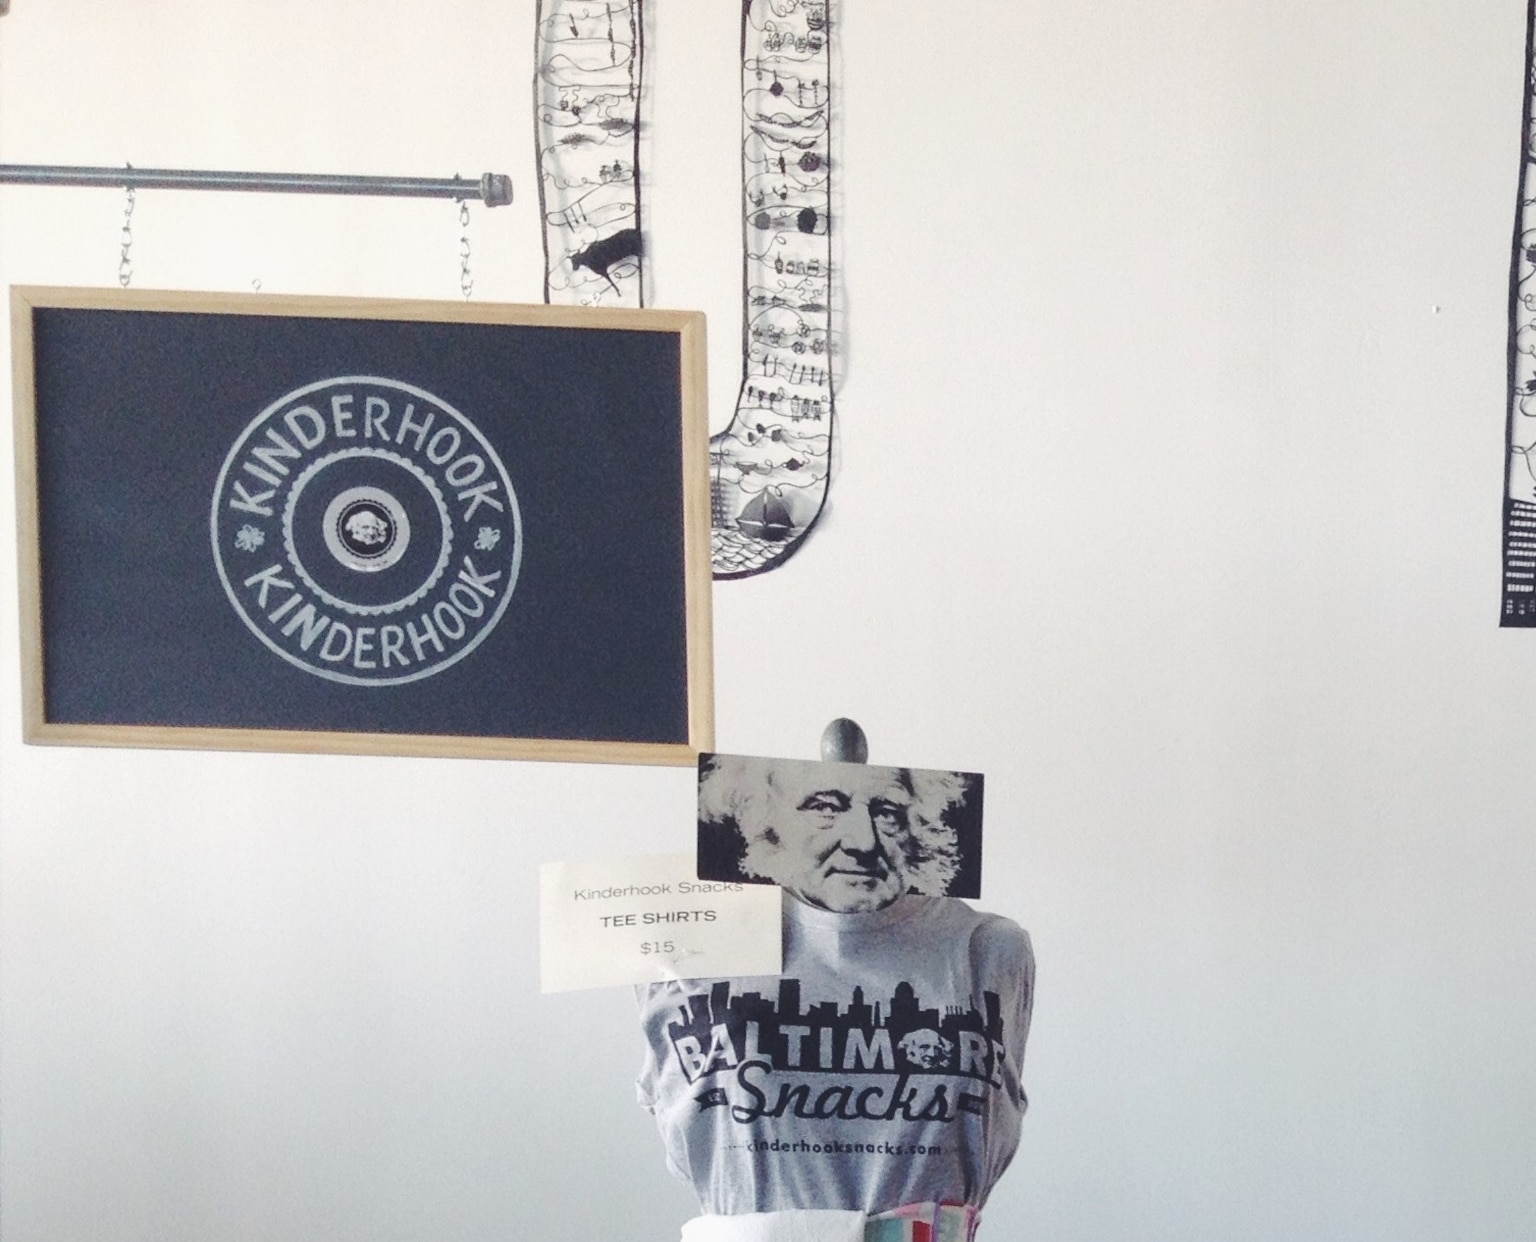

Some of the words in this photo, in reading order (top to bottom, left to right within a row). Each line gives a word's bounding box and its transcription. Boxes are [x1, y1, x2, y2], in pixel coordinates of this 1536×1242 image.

[229, 394, 505, 520] KINDERHOOK
[244, 556, 503, 669] KINDERHOOK
[574, 883, 672, 901] Kinderhook
[678, 881, 744, 894] Snacks
[600, 914, 637, 928] TEE
[642, 910, 717, 925] SHIRTS
[640, 941, 676, 955] $15
[674, 1020, 1004, 1083] BALTIMRE
[732, 1060, 955, 1123] Snacks
